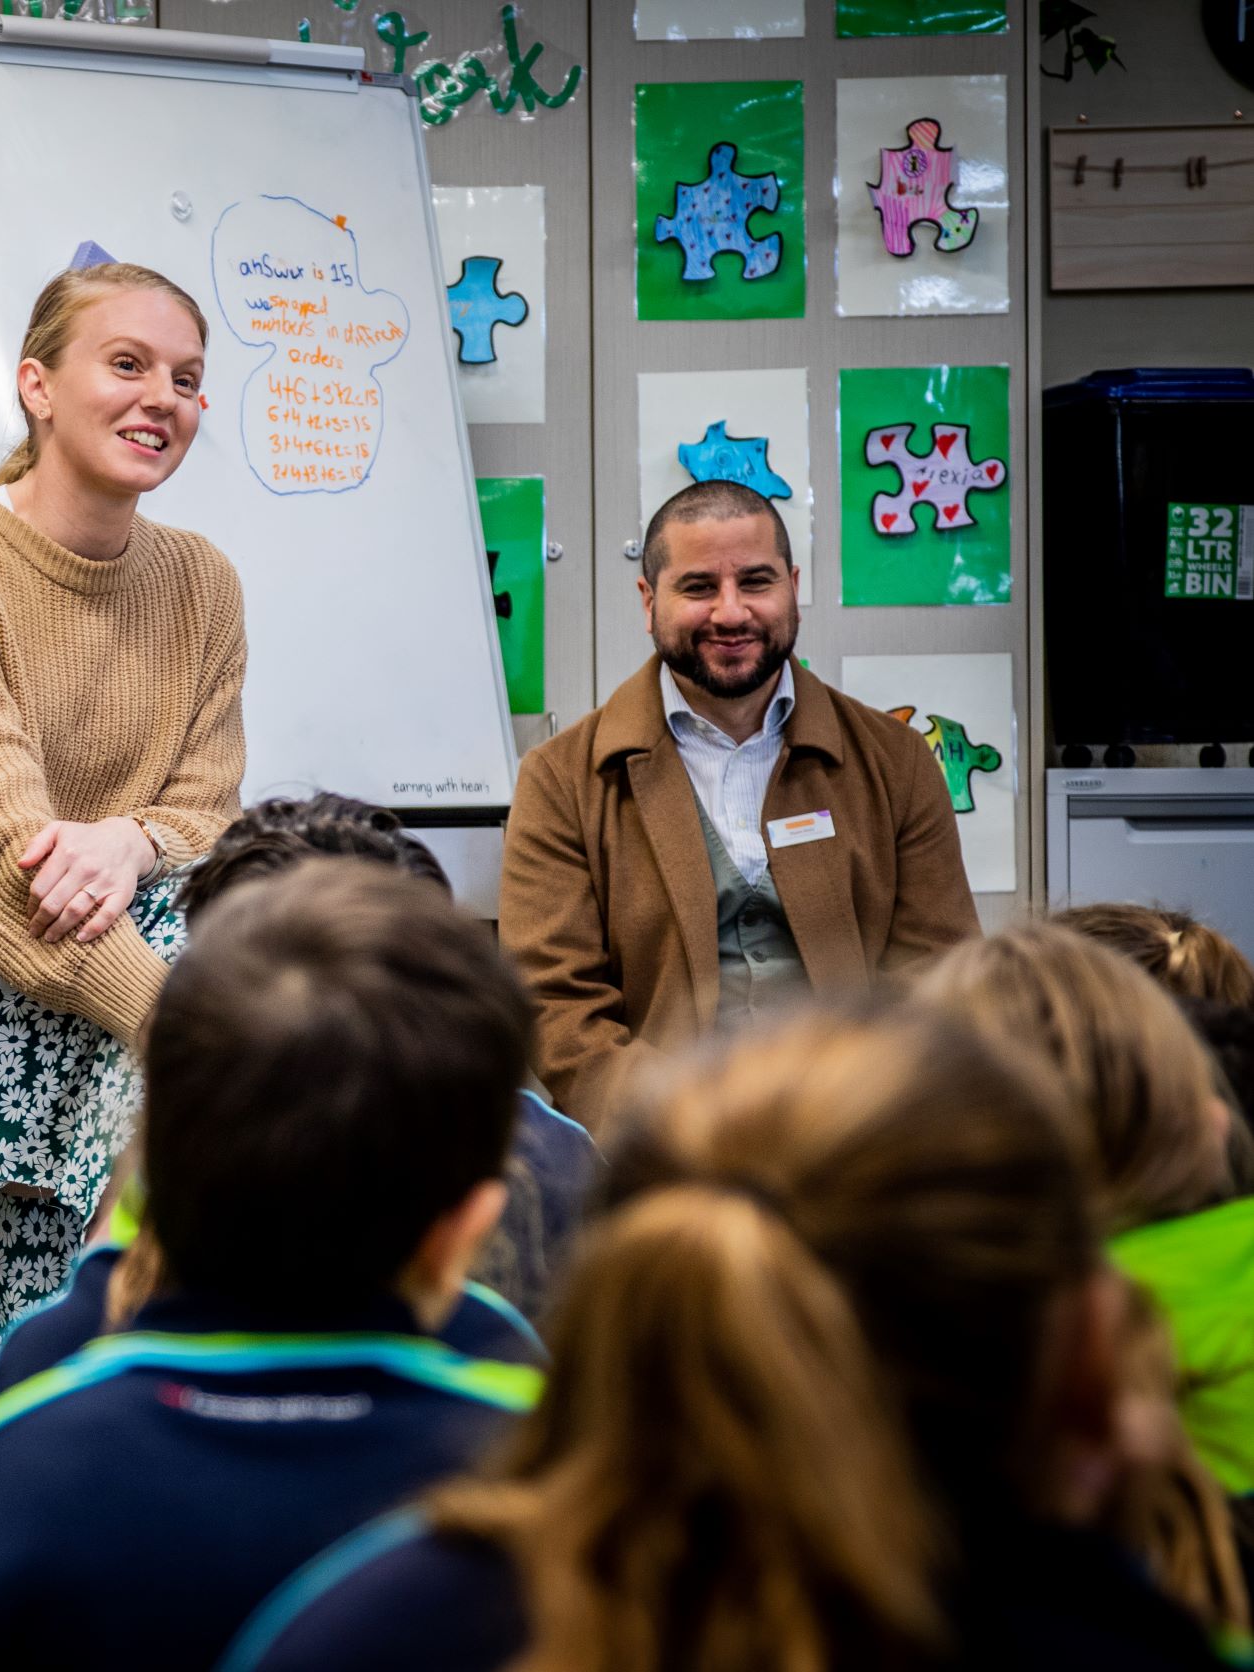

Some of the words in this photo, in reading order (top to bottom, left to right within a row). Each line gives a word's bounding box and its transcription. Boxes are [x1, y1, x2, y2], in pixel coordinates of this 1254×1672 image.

[312, 262, 325, 281] is
[331, 263, 354, 287] 15
[246, 298, 272, 311] we
[327, 325, 339, 339] in
[1188, 507, 1233, 537] 32
[1187, 540, 1232, 560] LTR
[1187, 562, 1232, 572] WHEELIE
[1185, 572, 1233, 595] BIN
[393, 781, 433, 799] earning
[435, 777, 459, 793] with
